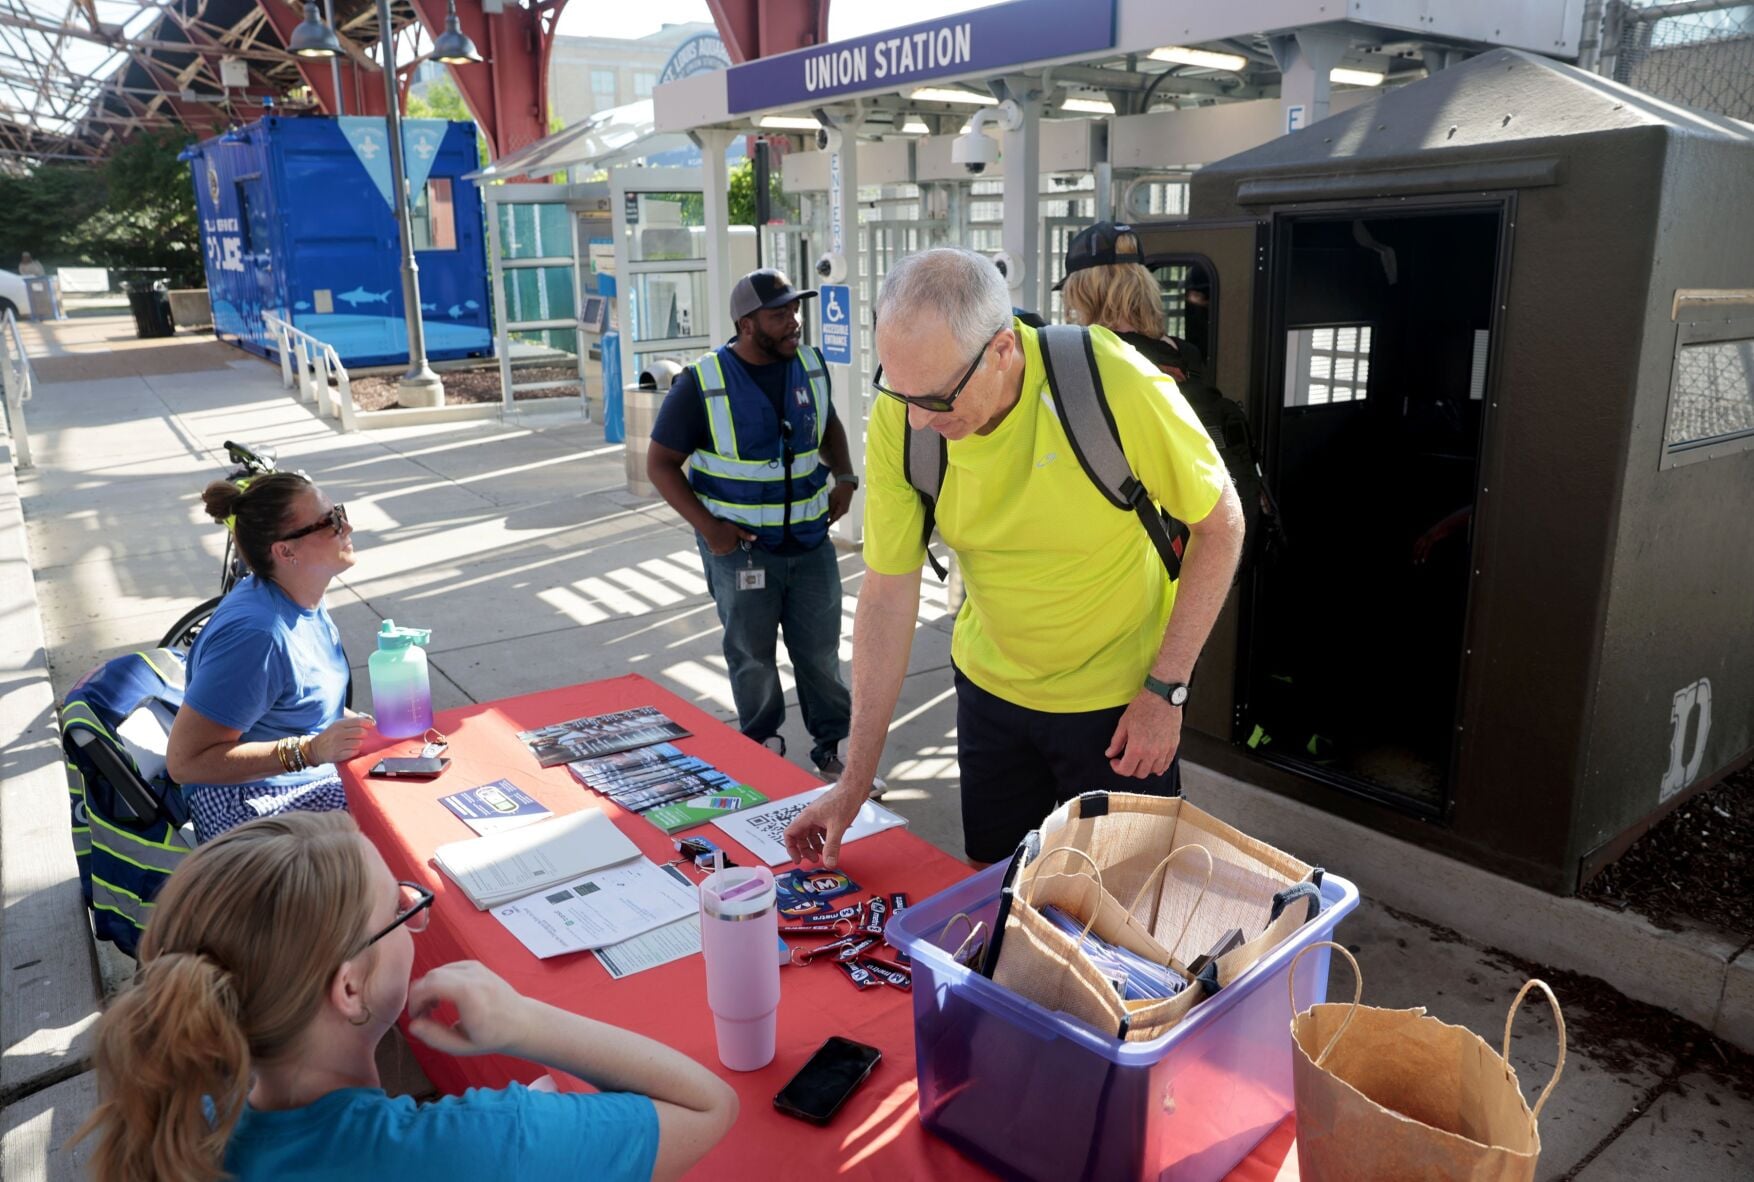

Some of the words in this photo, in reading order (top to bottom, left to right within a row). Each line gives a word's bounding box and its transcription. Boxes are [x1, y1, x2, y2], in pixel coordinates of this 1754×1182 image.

[805, 46, 867, 92] UNION
[874, 23, 971, 78] STATION
[831, 153, 841, 236] ENTER
[795, 390, 809, 404] M
[816, 880, 836, 889] M
